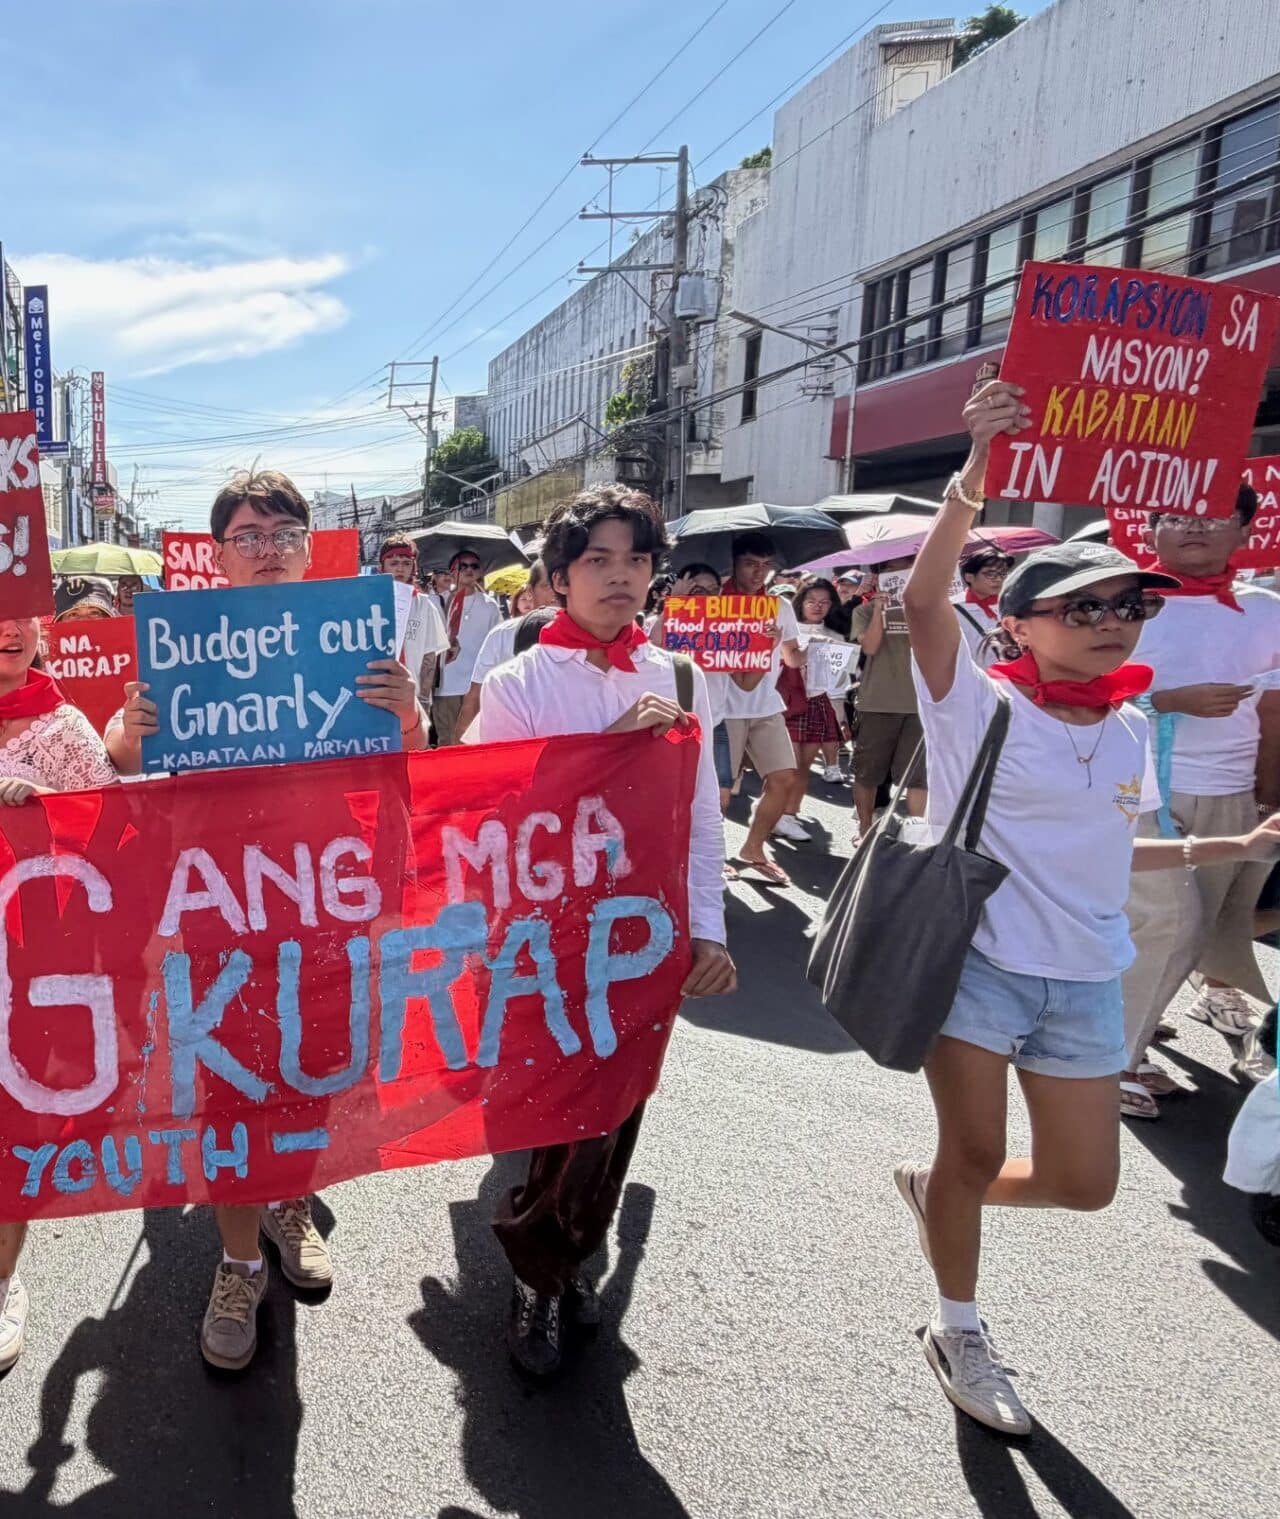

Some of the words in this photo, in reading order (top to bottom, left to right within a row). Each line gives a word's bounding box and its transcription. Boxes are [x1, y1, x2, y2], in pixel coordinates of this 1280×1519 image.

[1030, 271, 1212, 339] KORAPSYON
[1221, 294, 1260, 351] SA
[31, 317, 45, 433] Metrobank
[1081, 334, 1210, 395] NASYON?
[1040, 386, 1197, 449] KABATAAN
[1000, 442, 1063, 498] IN
[1088, 448, 1219, 516] ACTION!
[166, 541, 220, 575] SAR
[664, 617, 705, 633] flood
[705, 595, 780, 619] BILLION
[44, 653, 131, 680] KORAP
[148, 611, 300, 679] Budget
[319, 604, 396, 656] cut,
[665, 631, 751, 652] BACOLOD
[702, 649, 771, 669] SINKING
[170, 673, 353, 741] Gnarly
[304, 736, 391, 759] PARTYLIST
[157, 836, 383, 938] ANG
[441, 795, 632, 909] MGA
[160, 895, 674, 1121] KURAP
[15, 1121, 249, 1196] YOUTH
